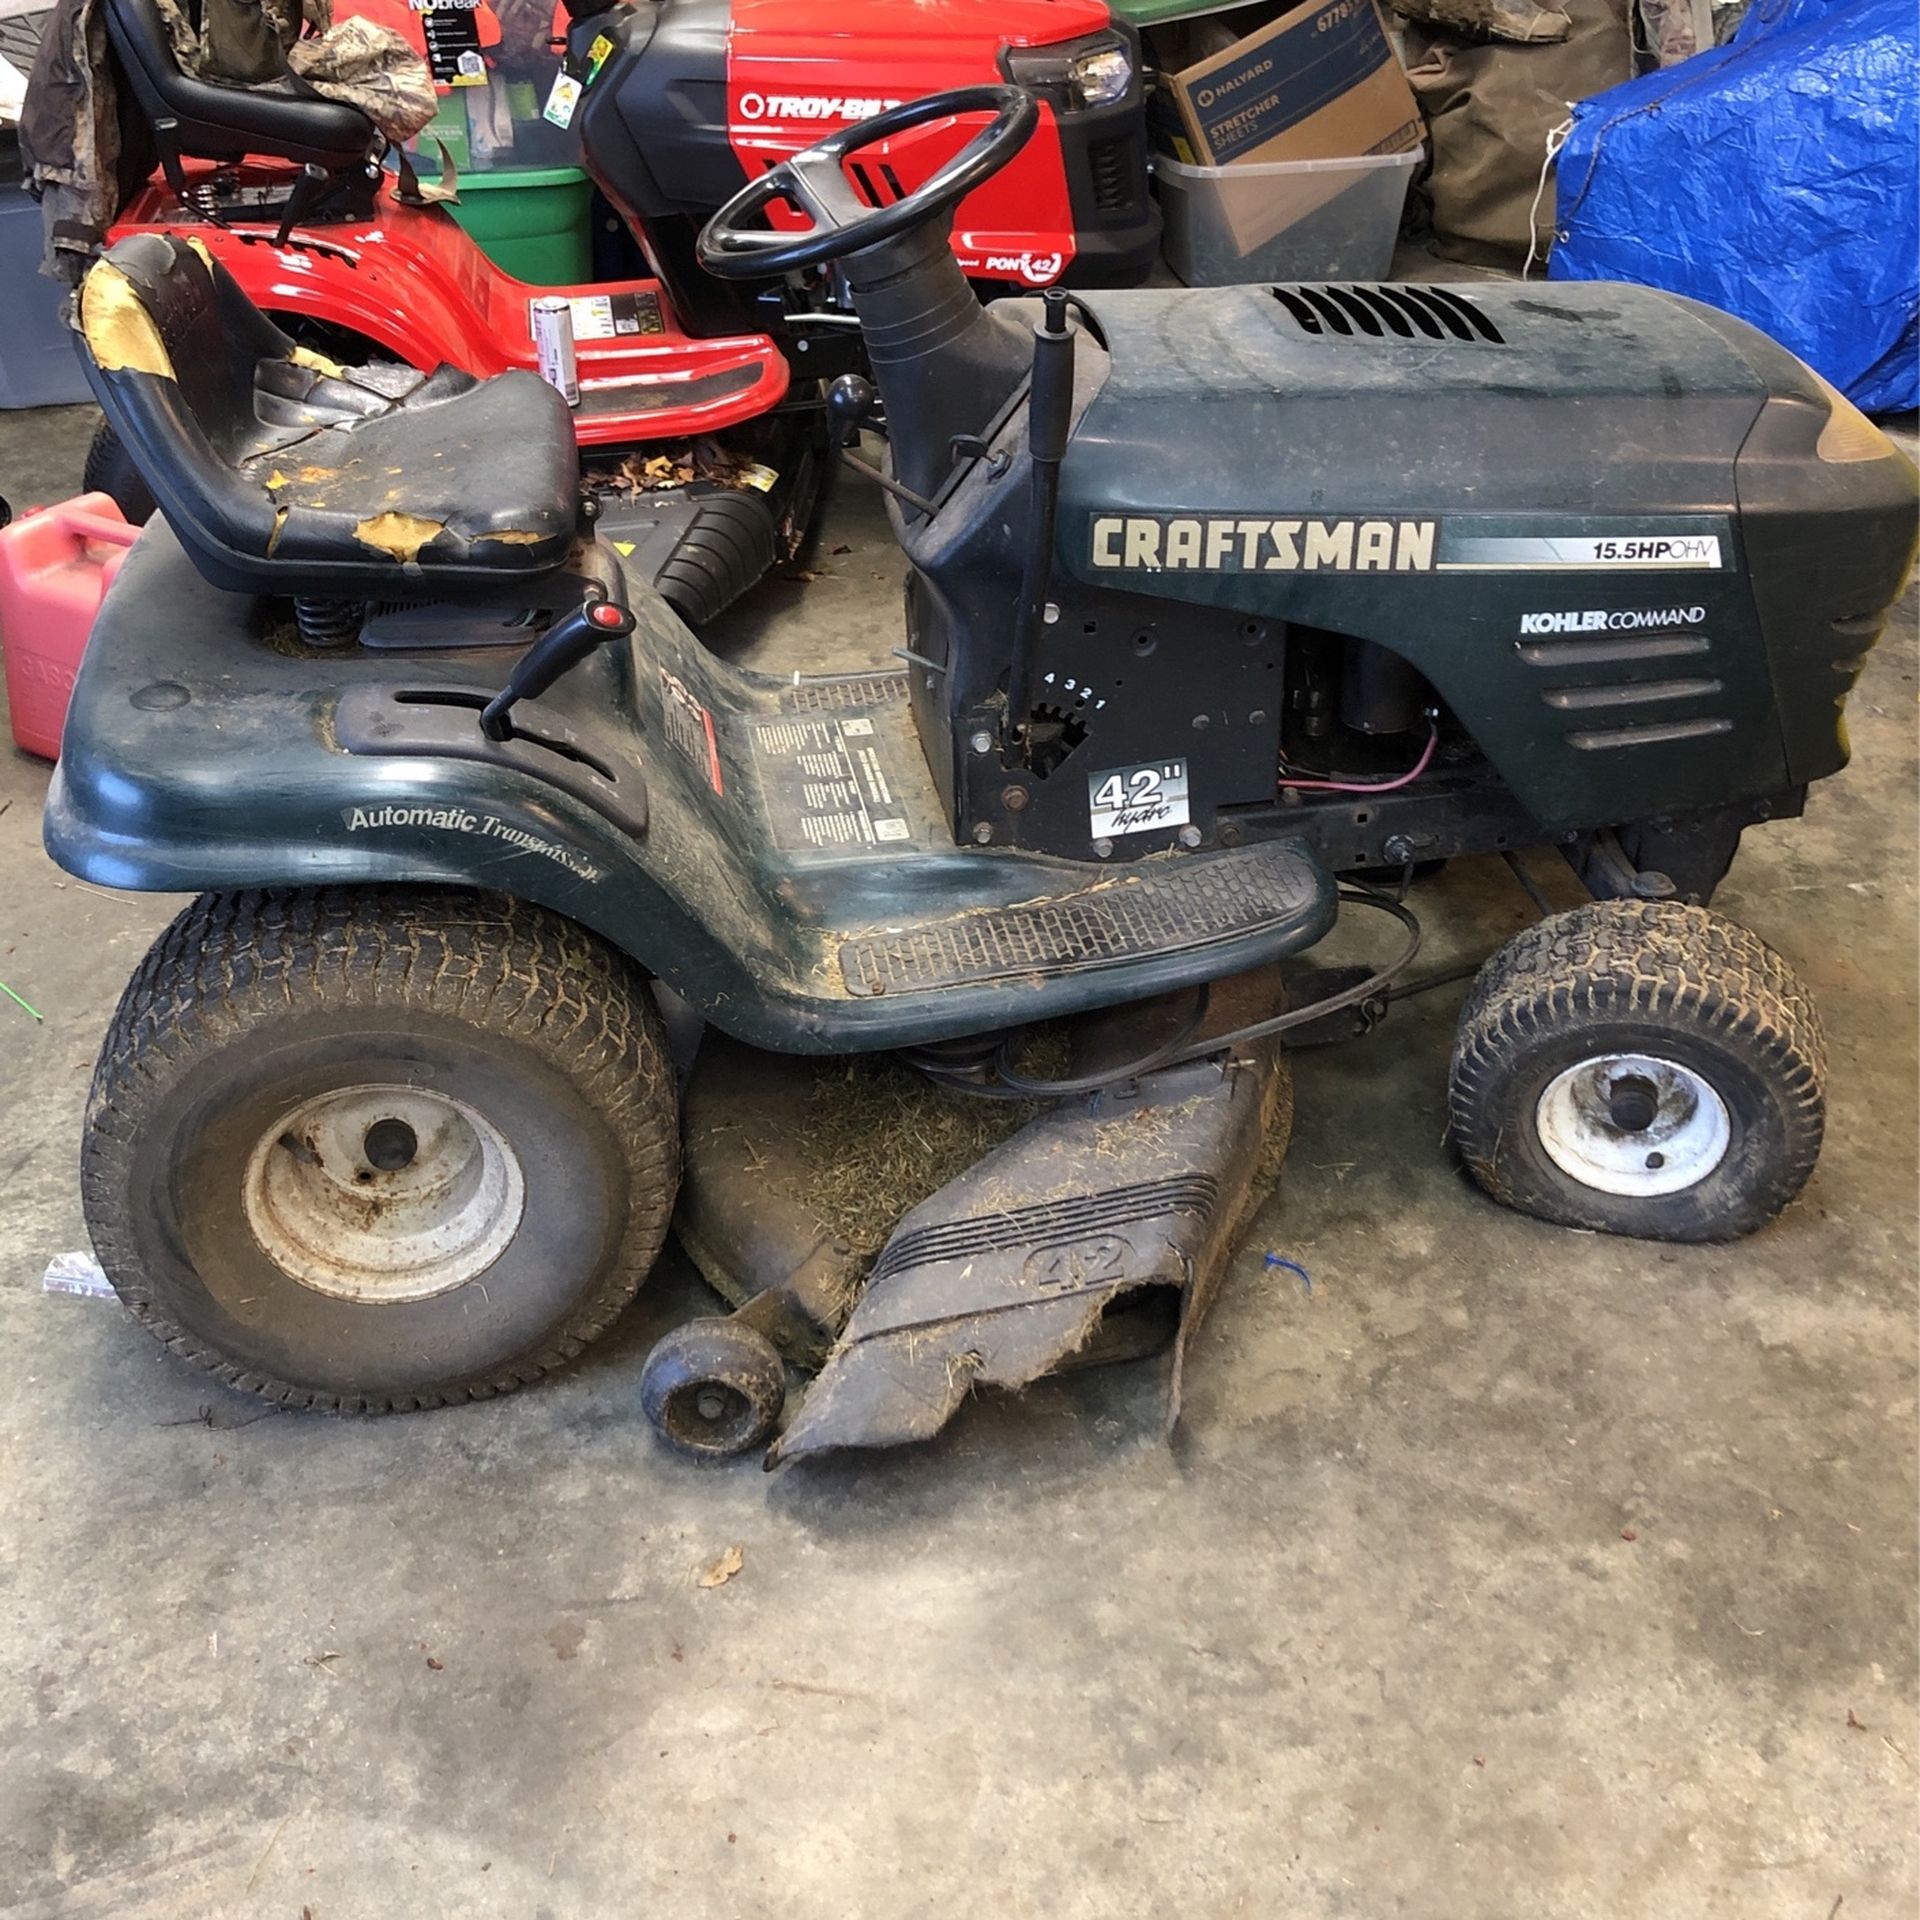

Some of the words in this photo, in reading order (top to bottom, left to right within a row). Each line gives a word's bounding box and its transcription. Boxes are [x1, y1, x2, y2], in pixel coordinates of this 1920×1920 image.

[1215, 59, 1273, 97] HALYARD
[1210, 94, 1280, 139] STRETCHER
[1214, 120, 1259, 150] SHEETS
[985, 256, 1031, 271] PONY
[1031, 258, 1052, 272] 42
[1093, 518, 1435, 570] CRAFTSMAN
[1520, 610, 1608, 634] KOHLER
[1608, 606, 1706, 630] COMMAND
[1044, 672, 1056, 684] 4
[1064, 678, 1077, 690] 3
[1080, 687, 1093, 699] 2
[1095, 699, 1107, 710] 1
[1095, 763, 1181, 810] 42"
[350, 805, 477, 832] Automatic
[1111, 803, 1172, 834] hydro
